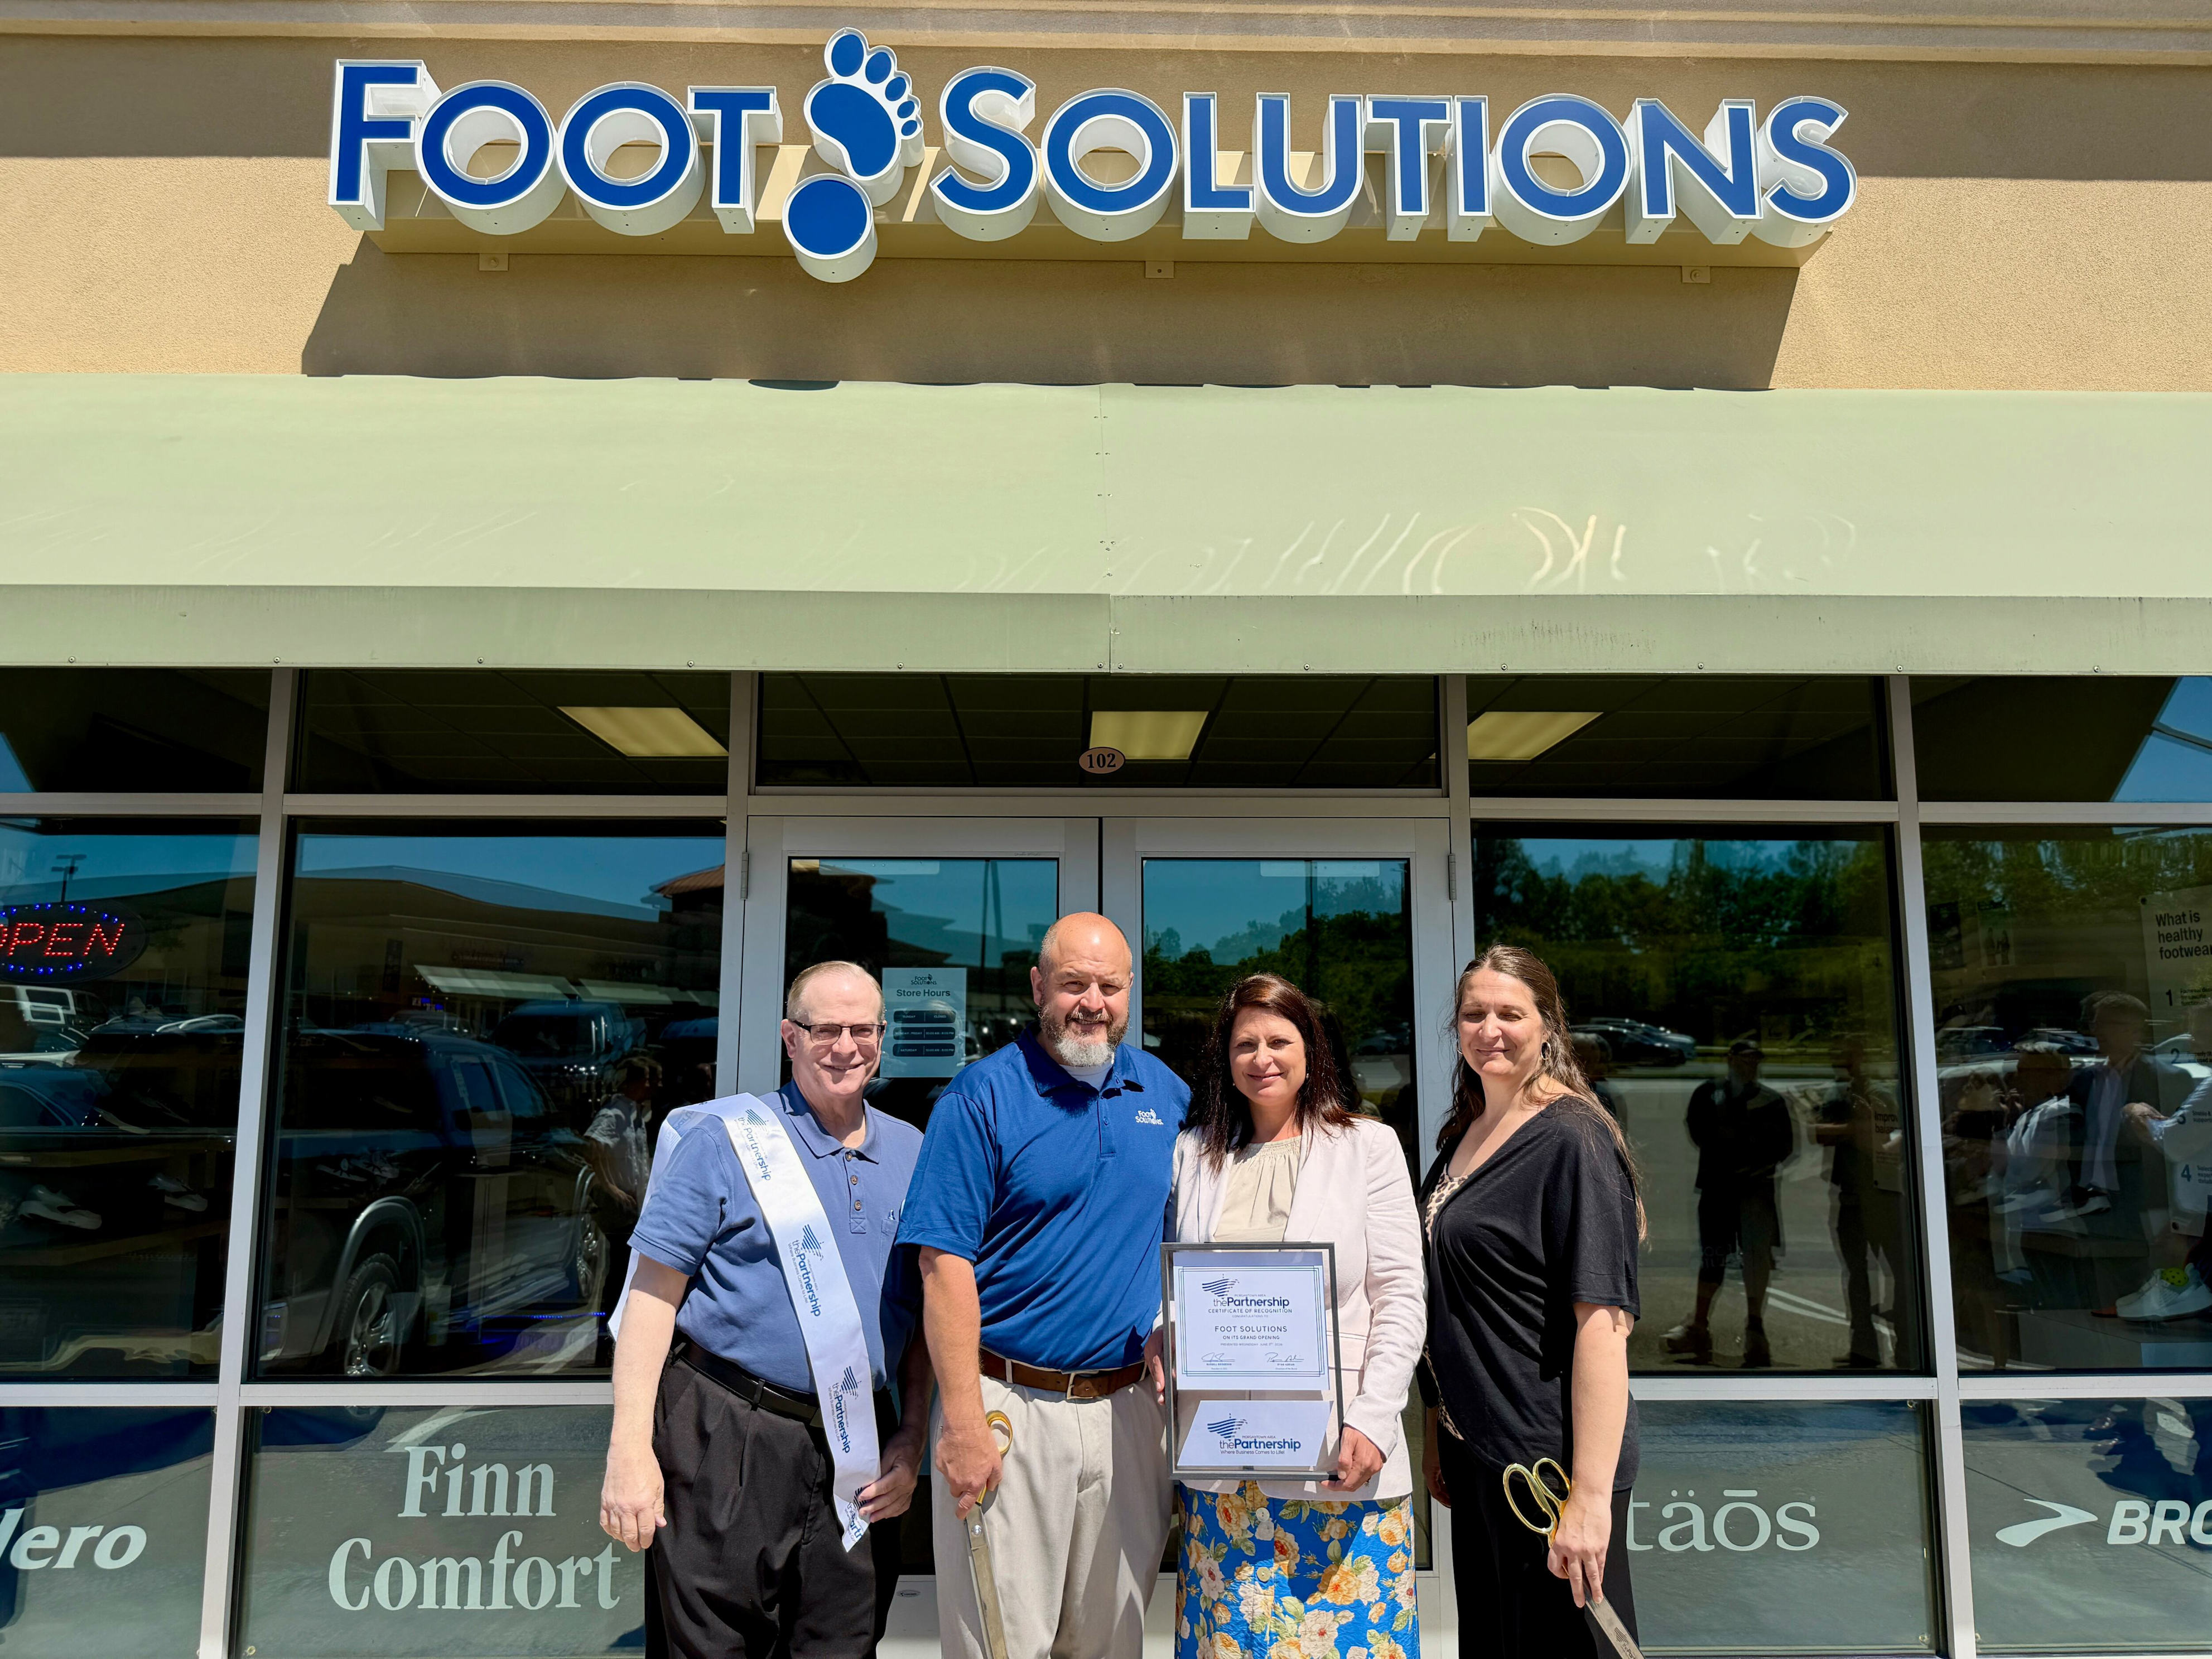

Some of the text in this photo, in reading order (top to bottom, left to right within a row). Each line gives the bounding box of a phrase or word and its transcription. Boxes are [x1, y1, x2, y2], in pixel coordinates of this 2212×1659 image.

[329, 59, 1857, 229] FOOT SOLUTIONS
[1087, 754, 1116, 768] 102
[2155, 910, 2200, 927] What is
[2157, 927, 2203, 943] healthy
[2165, 990, 2173, 1006] 1
[2171, 1048, 2180, 1063] 2
[2181, 1164, 2191, 1182] 4
[1213, 1296, 1289, 1309] thePartnership
[1220, 1438, 1301, 1451] thePartnership
[397, 1443, 556, 1517] Finn
[329, 1530, 621, 1610] Comfort
